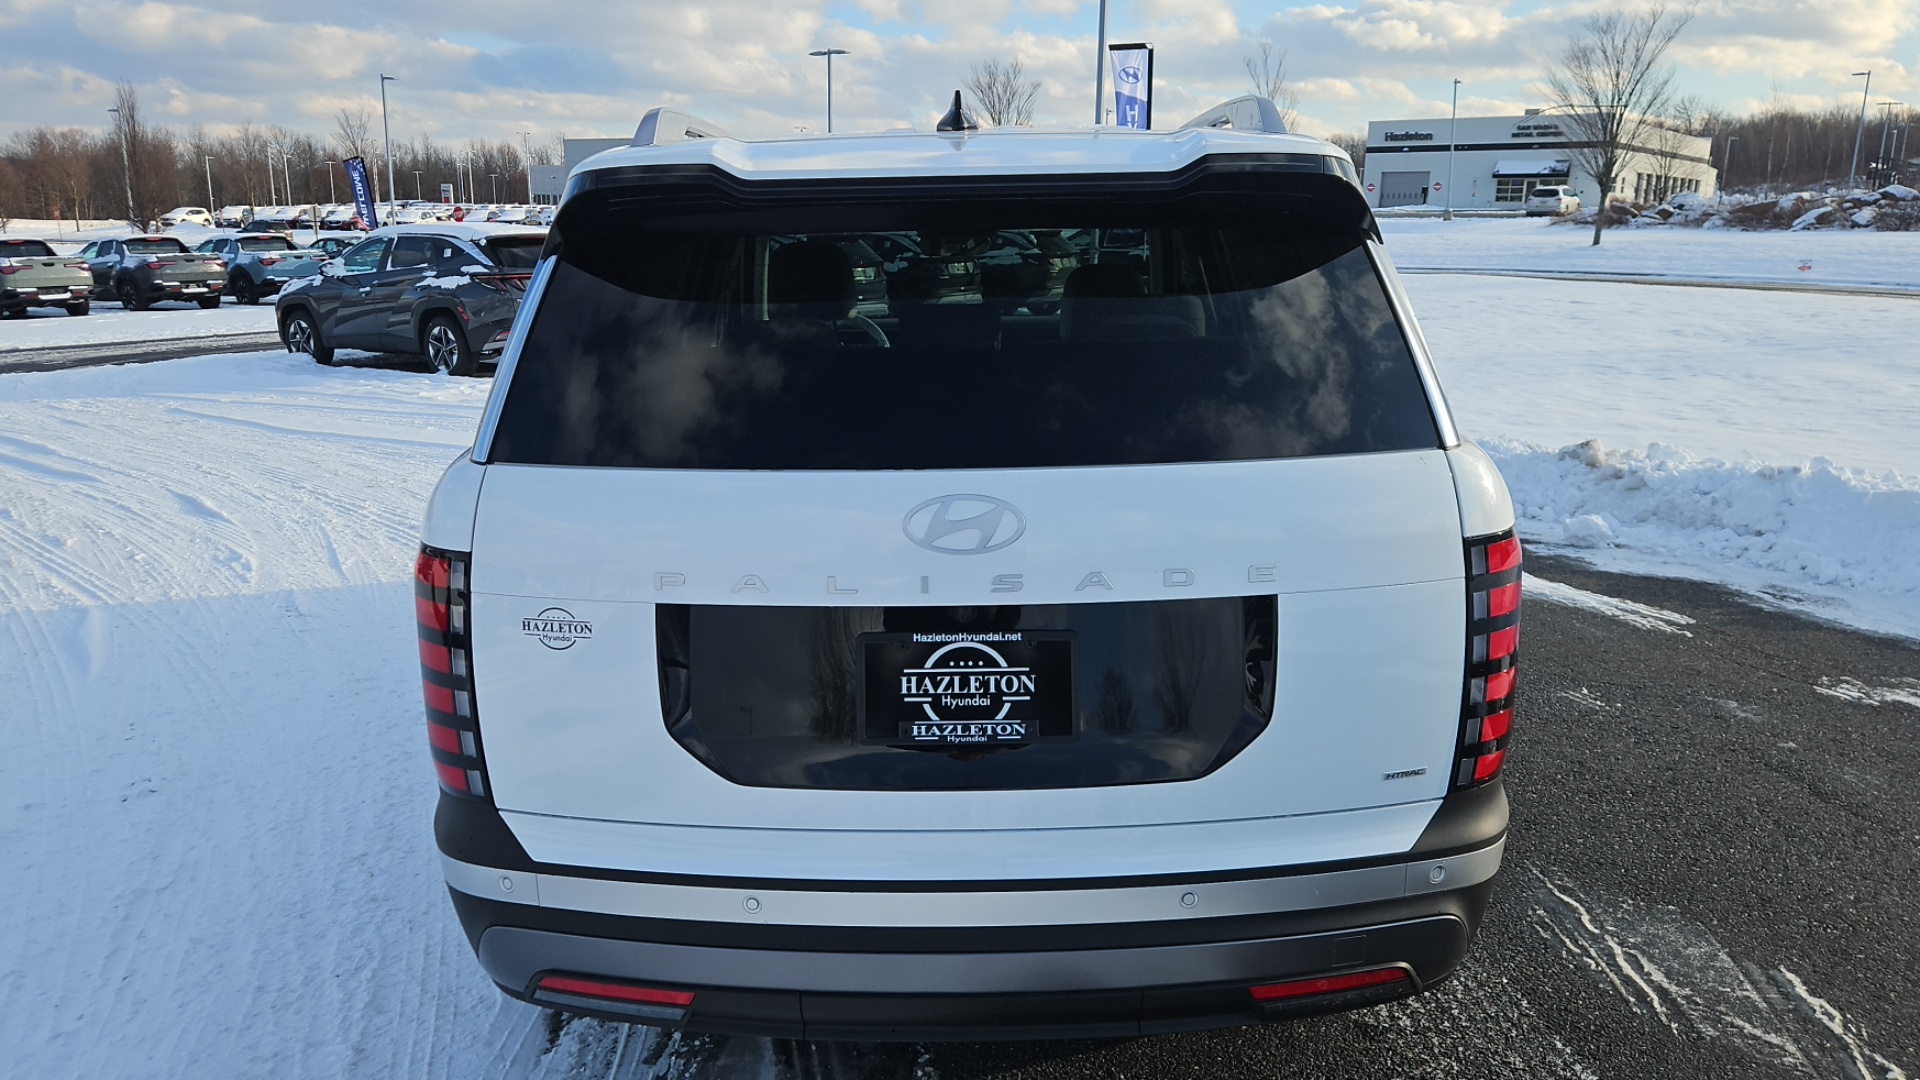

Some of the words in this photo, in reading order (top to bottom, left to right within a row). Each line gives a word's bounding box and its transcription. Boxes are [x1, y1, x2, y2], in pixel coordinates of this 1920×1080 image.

[654, 563, 1279, 594] PALISADE
[522, 620, 592, 635] HAZLETON
[542, 633, 573, 643] Hyundai
[913, 632, 1022, 642] HazletonHyundai.net
[900, 674, 1036, 694] HAZLETON
[941, 695, 991, 709] Hyundai
[911, 723, 1027, 736] HAZLETON
[947, 735, 988, 743] Hyundai
[1385, 768, 1426, 780] HTRAC
